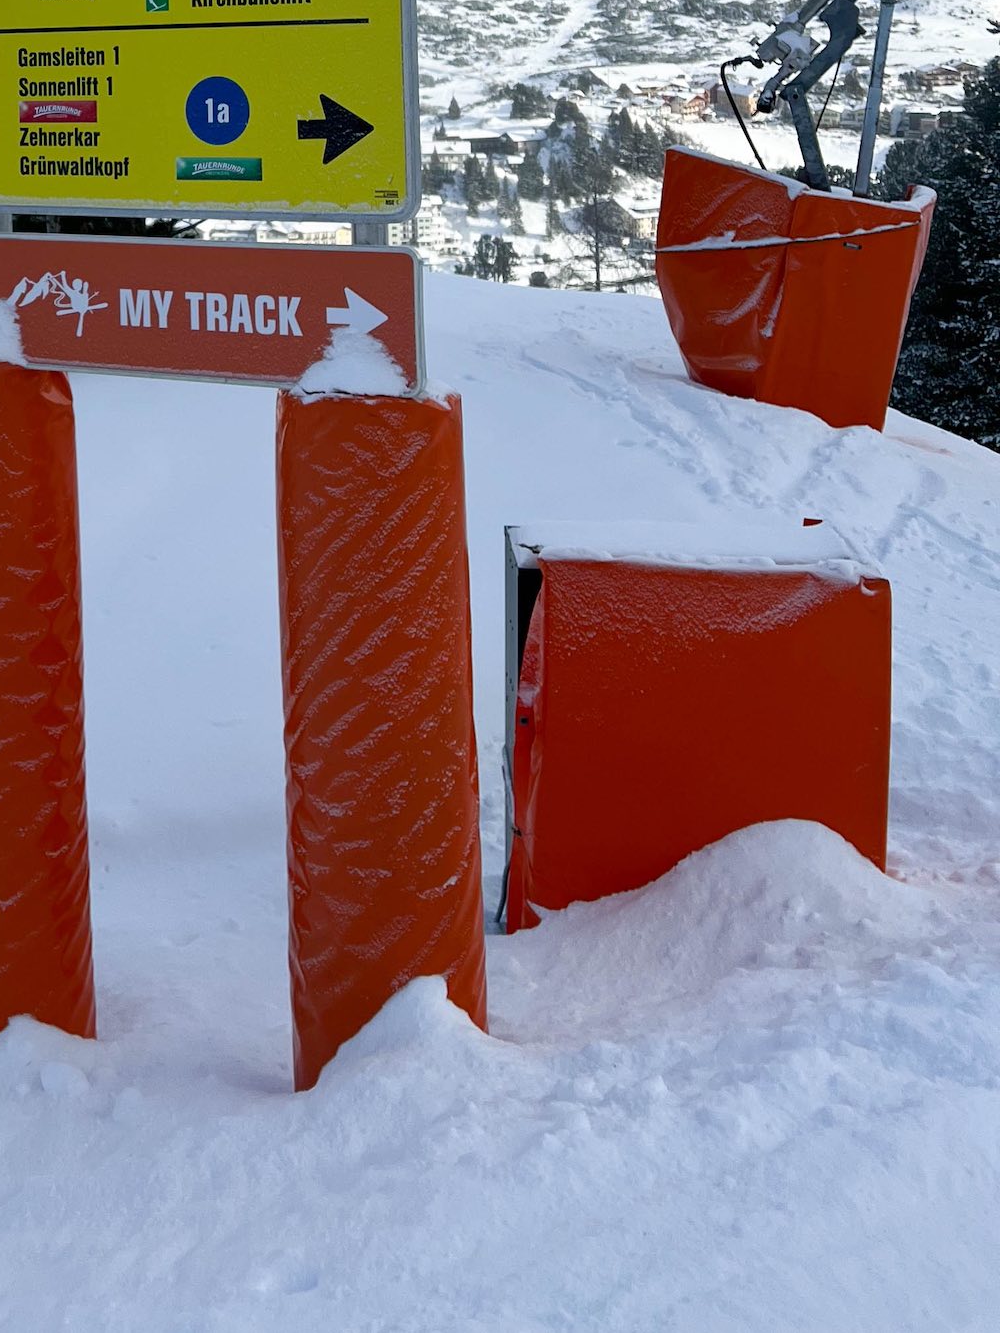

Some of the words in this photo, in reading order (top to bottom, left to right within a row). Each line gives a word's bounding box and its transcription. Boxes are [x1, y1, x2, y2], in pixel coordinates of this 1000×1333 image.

[18, 46, 105, 68] Gamsleiten
[112, 46, 120, 66] 1
[18, 76, 98, 98] Sonnenlift
[105, 76, 113, 96] 1
[34, 105, 82, 116] TAUERNRUNDE
[205, 98, 230, 124] 1a
[20, 127, 100, 148] Zehnerkar
[20, 155, 129, 179] Grünwaldkopf
[193, 162, 246, 174] TAUERNRUNDE
[119, 288, 174, 329] MY
[185, 291, 303, 337] TRACK
